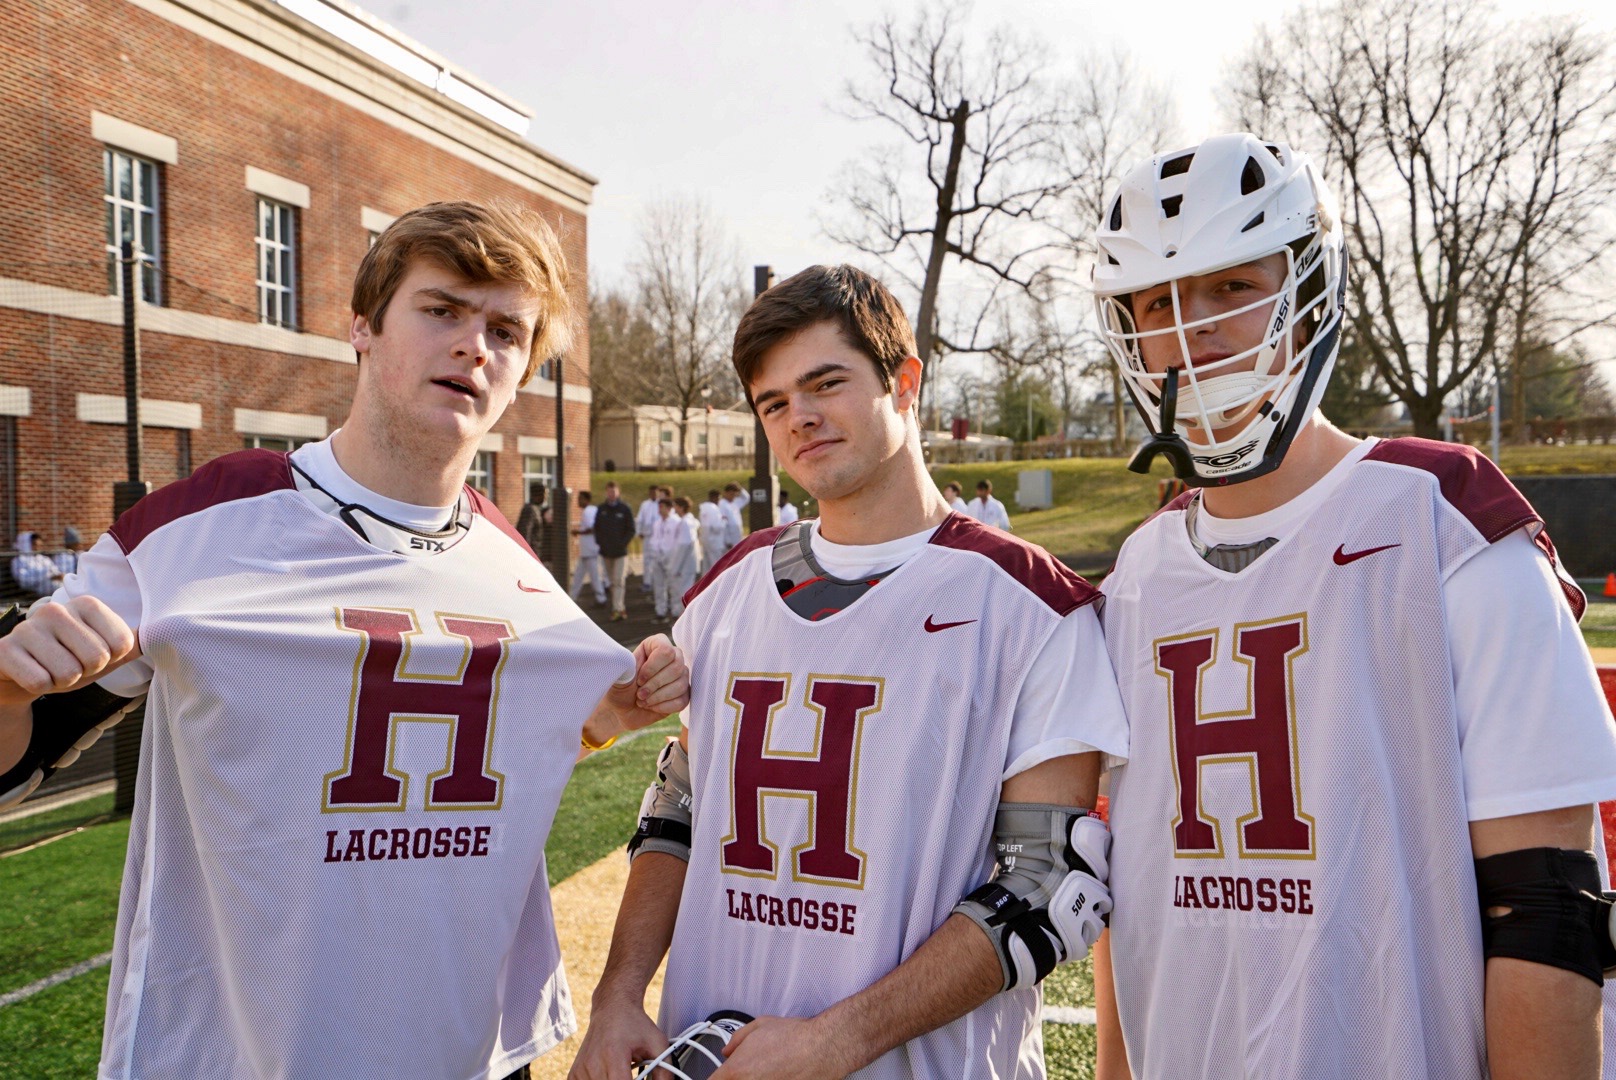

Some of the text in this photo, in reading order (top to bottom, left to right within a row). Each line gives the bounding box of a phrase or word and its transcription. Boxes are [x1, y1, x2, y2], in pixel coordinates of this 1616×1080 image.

[1206, 461, 1251, 474] cascade
[410, 537, 445, 551] STX
[321, 607, 520, 814] H
[1153, 611, 1310, 860] H
[720, 671, 885, 890] H
[324, 826, 491, 862] LACROSSE
[1006, 844, 1023, 853] LEFT
[726, 888, 857, 935] LACROSSE
[1072, 892, 1086, 917] 500
[1174, 875, 1314, 915] LACROSSE
